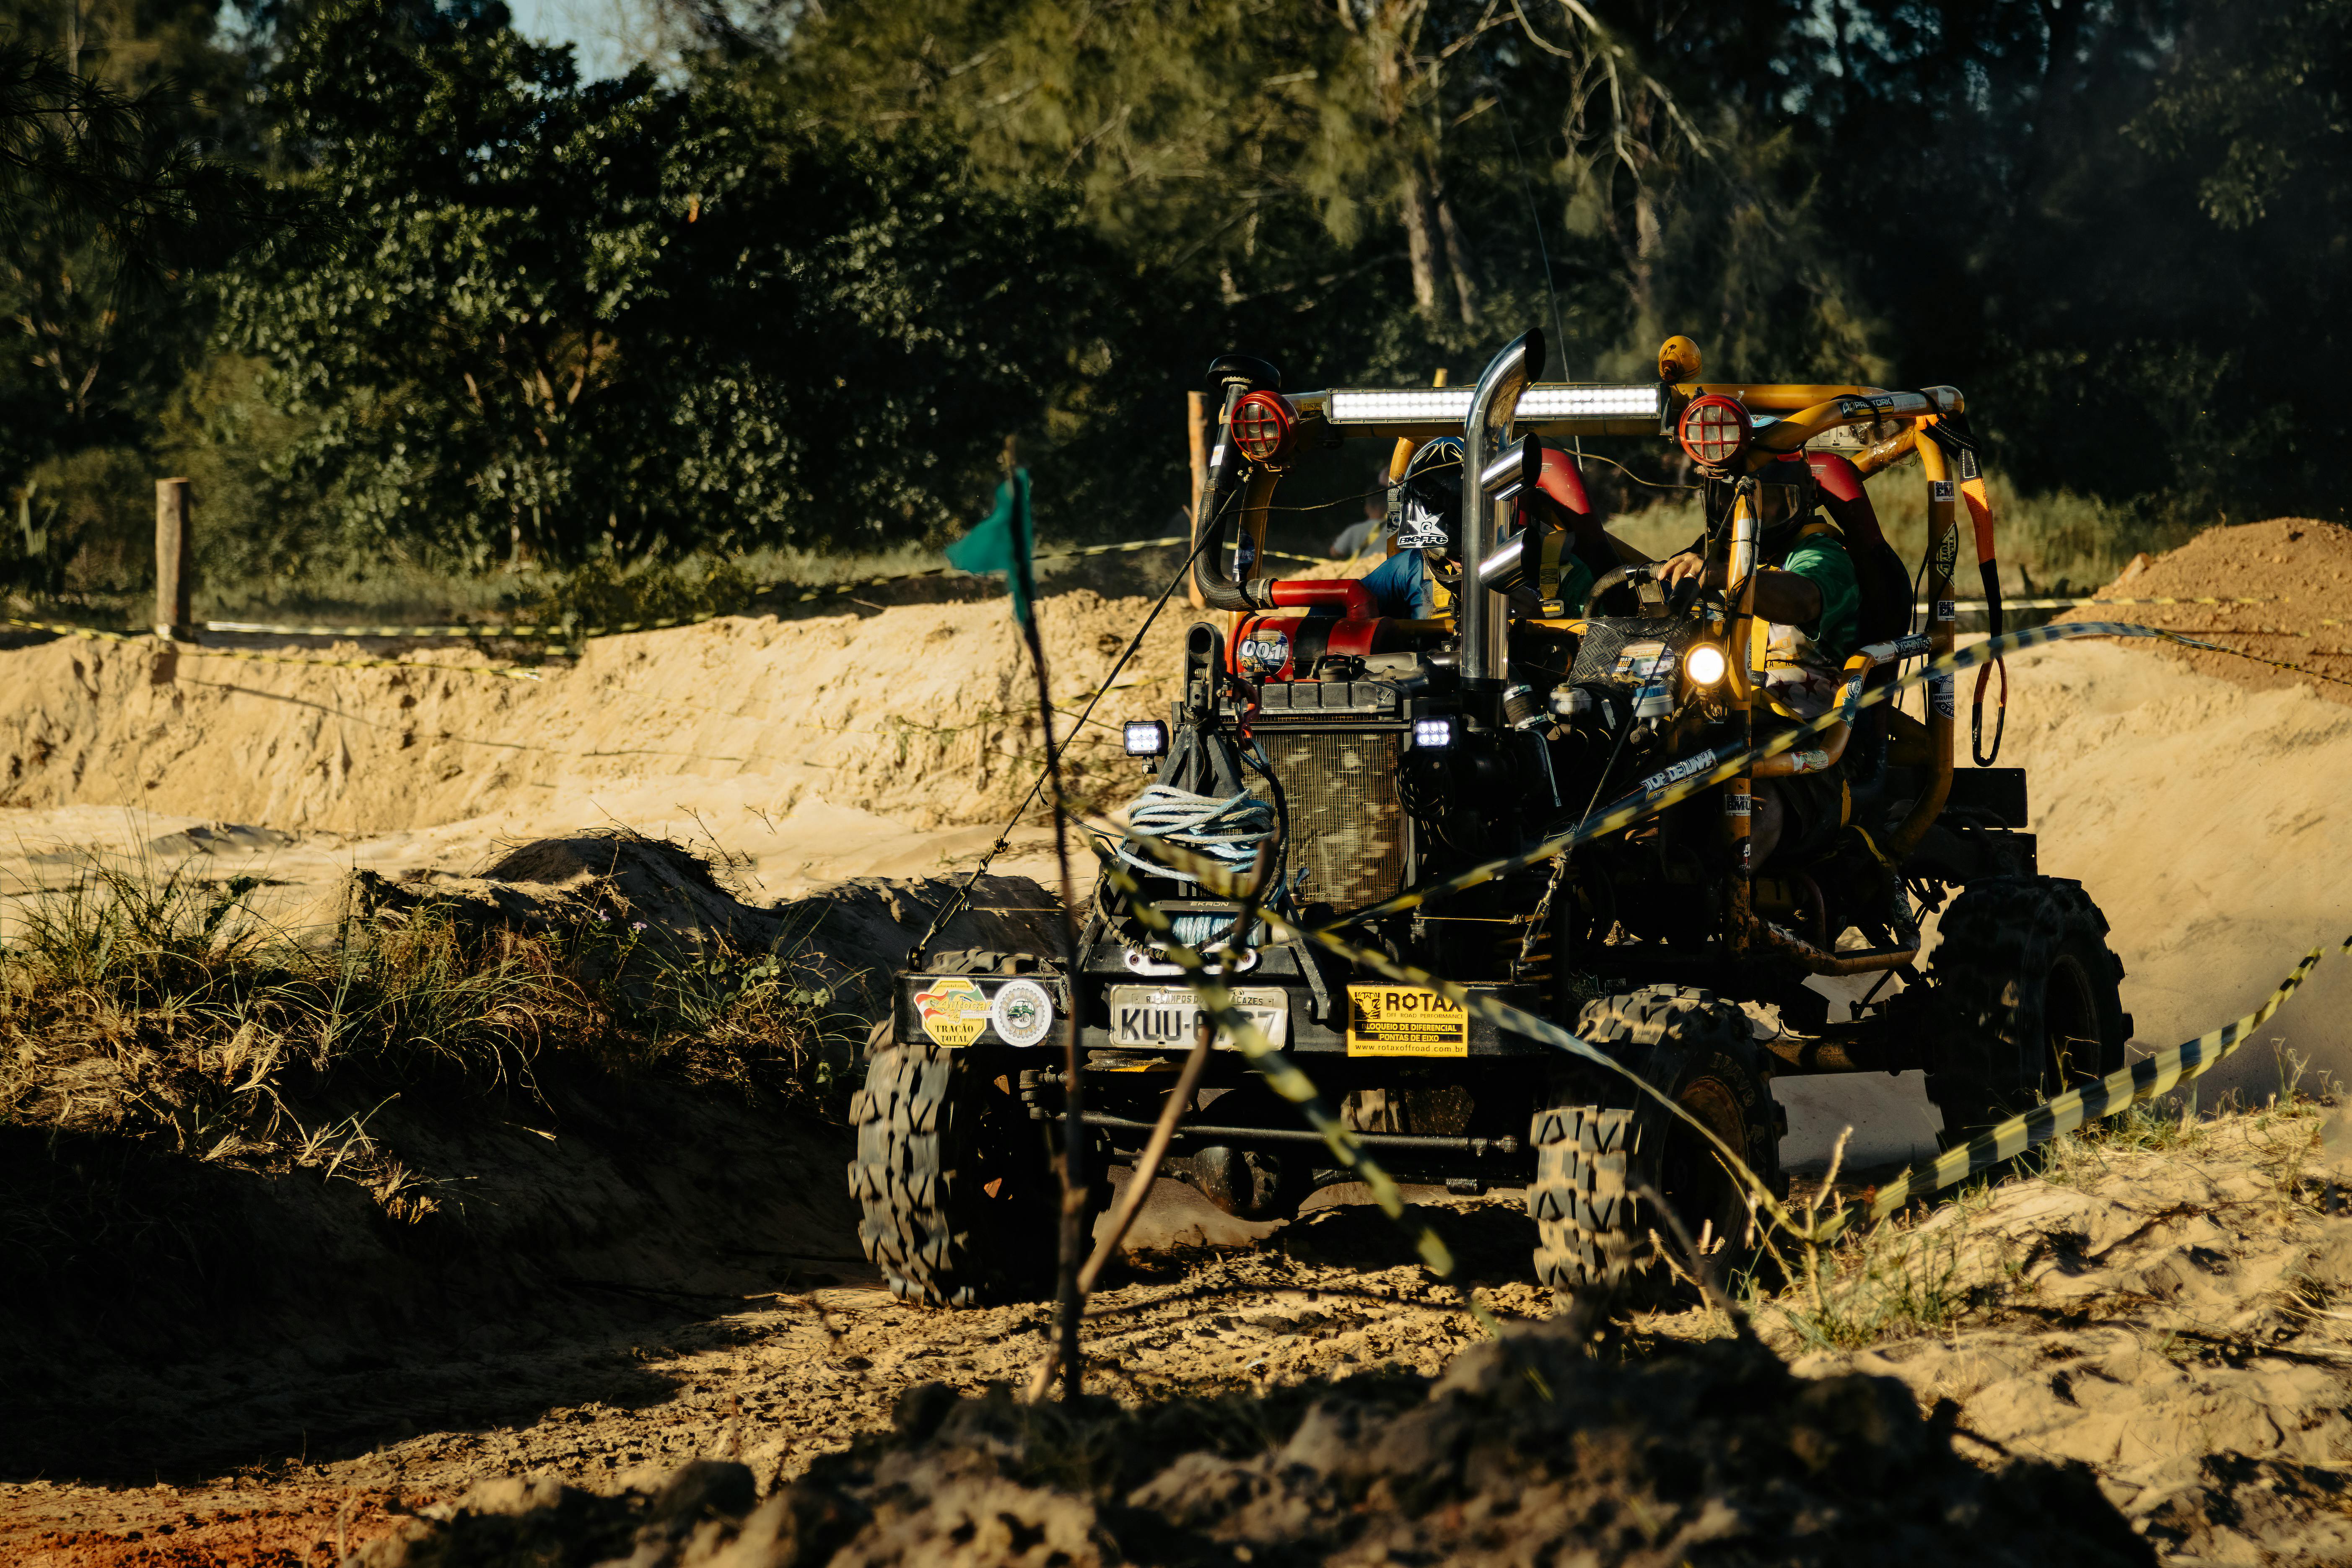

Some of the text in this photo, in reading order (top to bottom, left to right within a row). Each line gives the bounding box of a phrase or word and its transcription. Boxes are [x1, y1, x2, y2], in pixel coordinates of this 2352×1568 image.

[1871, 398, 1892, 406] TORK
[1242, 640, 1283, 660] 001
[1641, 772, 1666, 791] TOP
[1668, 764, 1685, 782] DE
[1386, 993, 1463, 1012] ROTAX
[1355, 1044, 1463, 1052] www.rotaxoffroad.com.br
